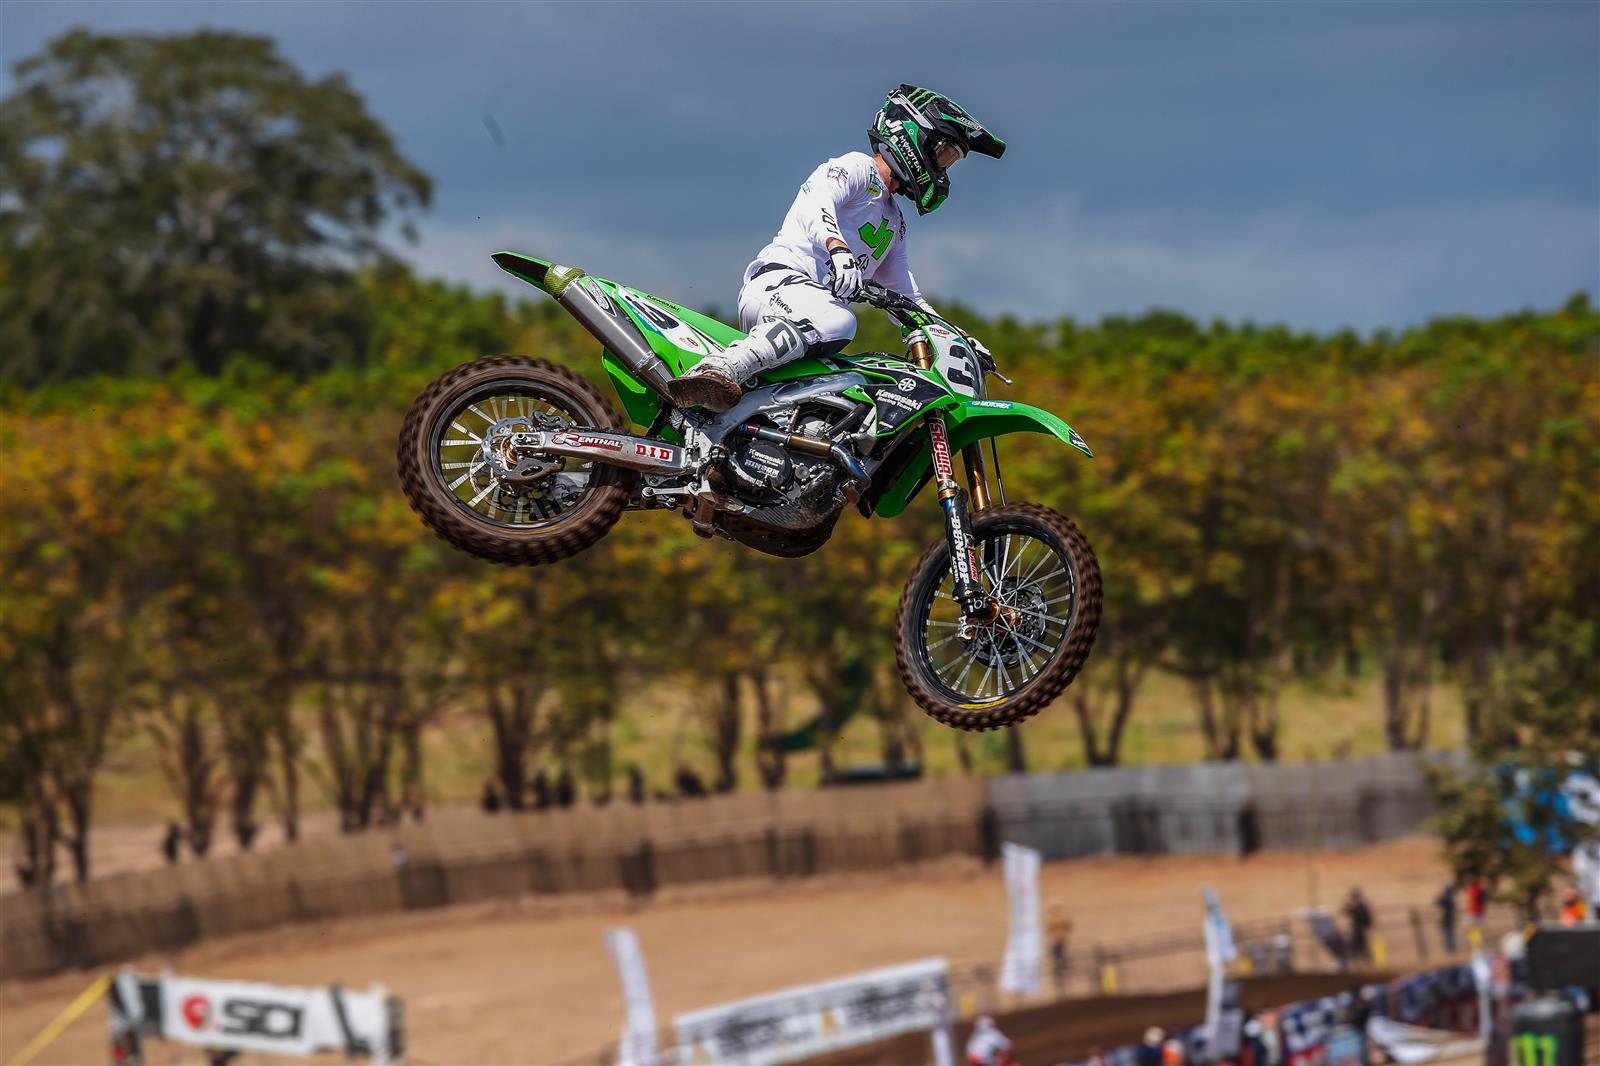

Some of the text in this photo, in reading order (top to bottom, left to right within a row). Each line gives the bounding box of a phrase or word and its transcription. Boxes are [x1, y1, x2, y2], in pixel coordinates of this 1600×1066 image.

[898, 134, 922, 171] MONSTER
[947, 345, 979, 391] 3
[875, 389, 922, 410] Kawasaki
[877, 396, 912, 411] Racing Team
[979, 400, 1010, 410] MOTOREX
[552, 432, 623, 449] RENTHAL
[929, 423, 953, 476] SHOWA
[749, 448, 785, 465] Kawasaki
[951, 516, 969, 584] DUNLOP
